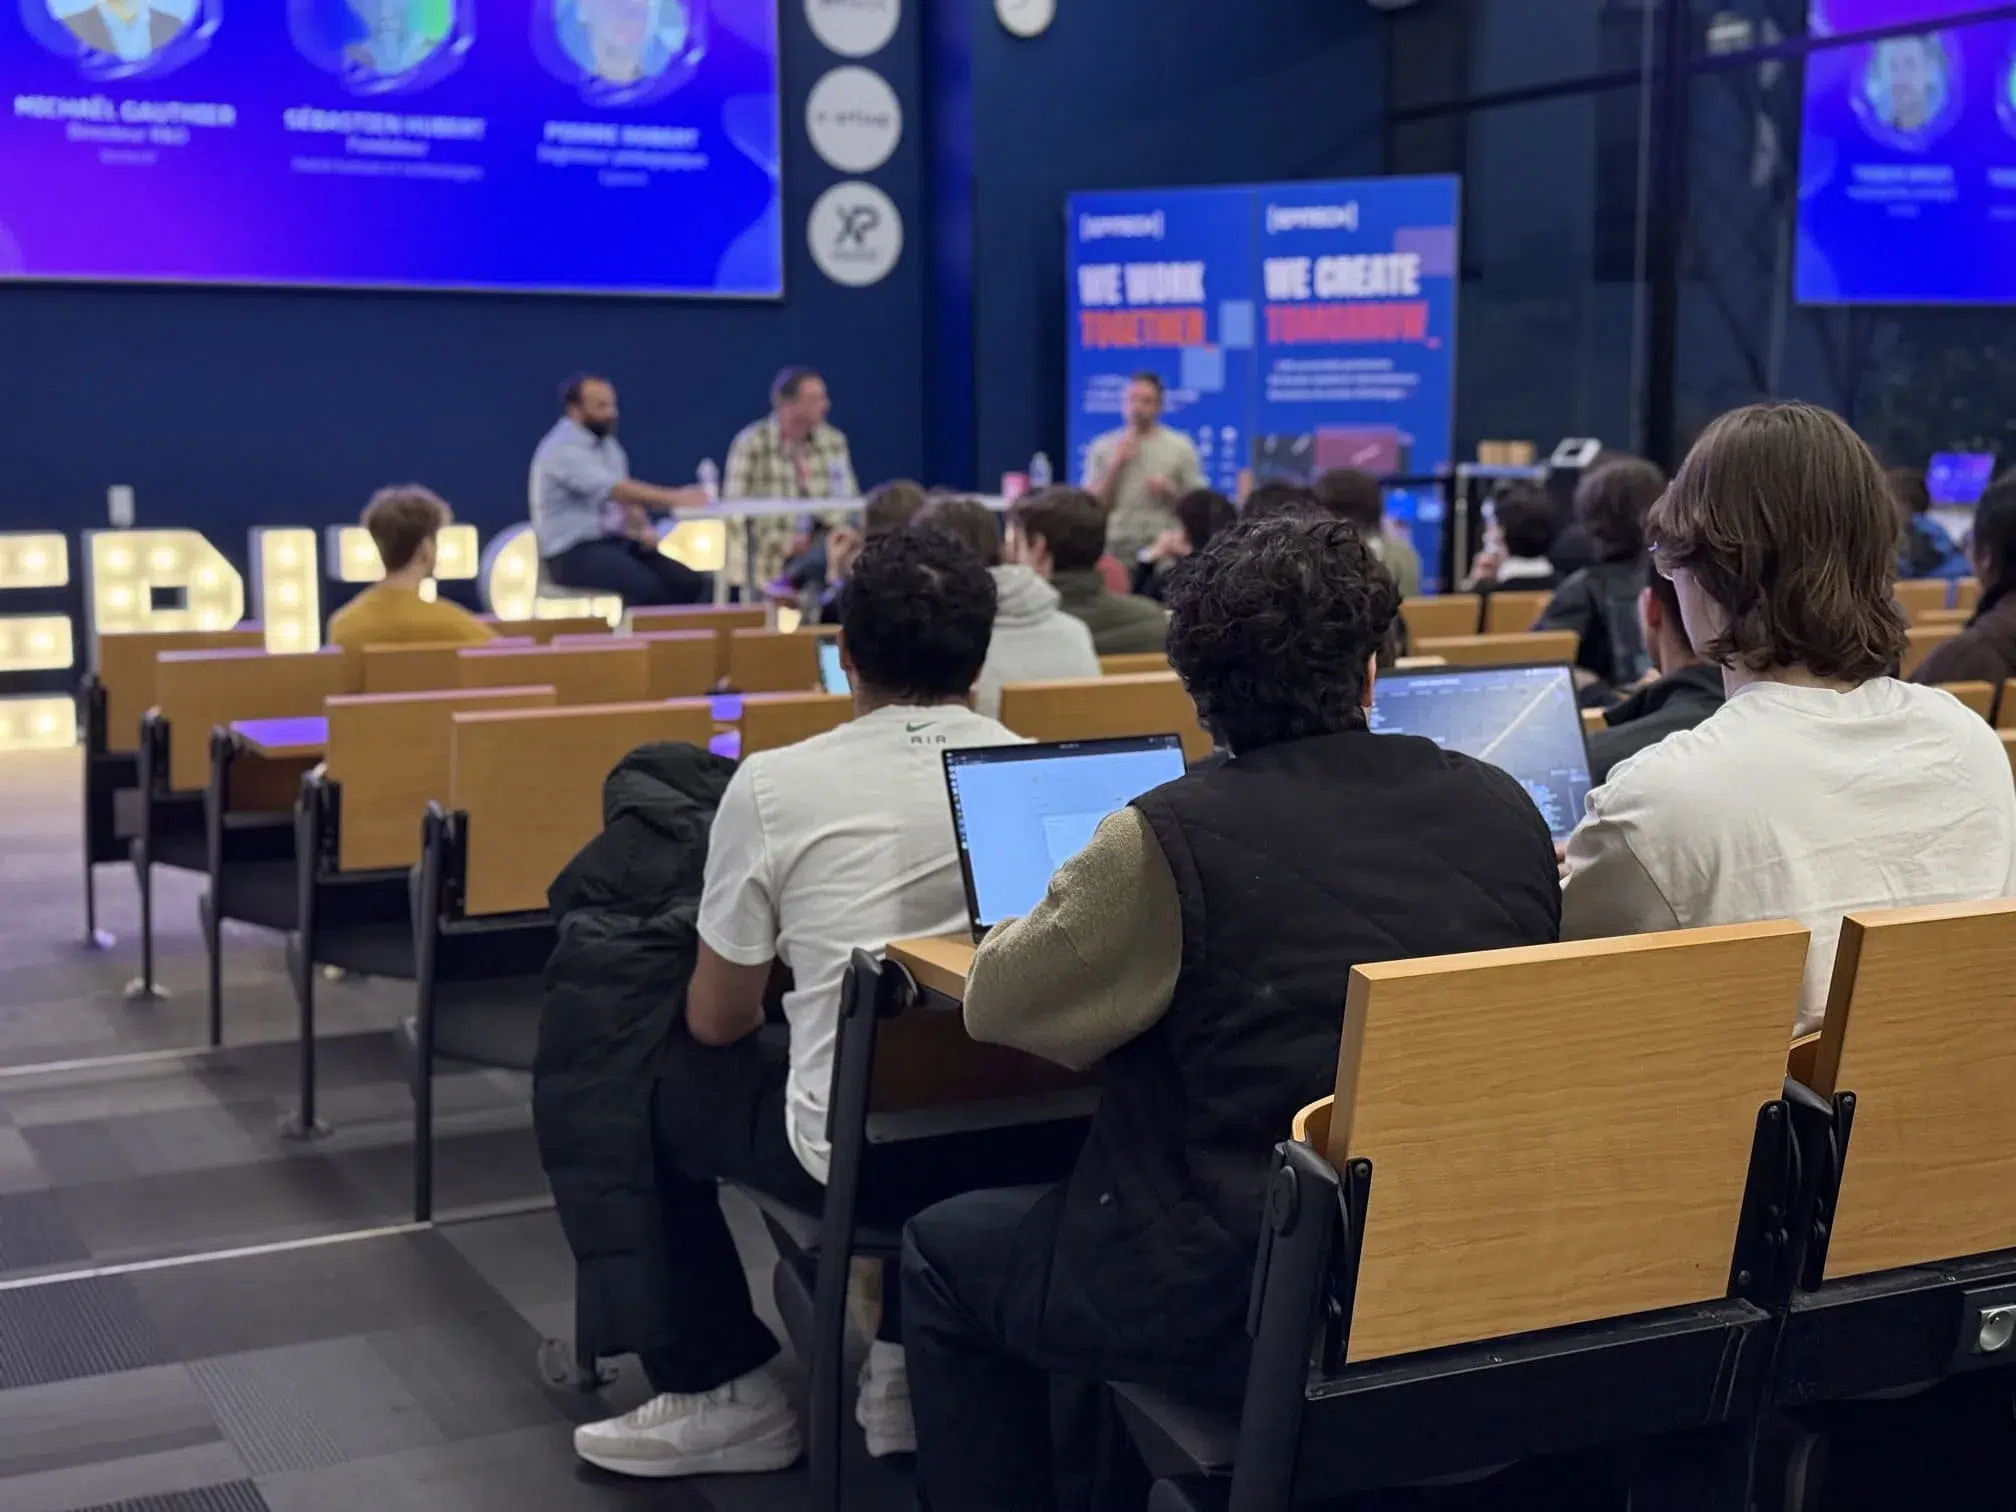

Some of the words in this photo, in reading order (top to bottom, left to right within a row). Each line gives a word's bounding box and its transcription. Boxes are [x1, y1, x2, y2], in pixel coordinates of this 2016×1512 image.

[1079, 264, 1122, 306] WE
[1264, 256, 1311, 301] WE
[1314, 252, 1421, 299] CREATE
